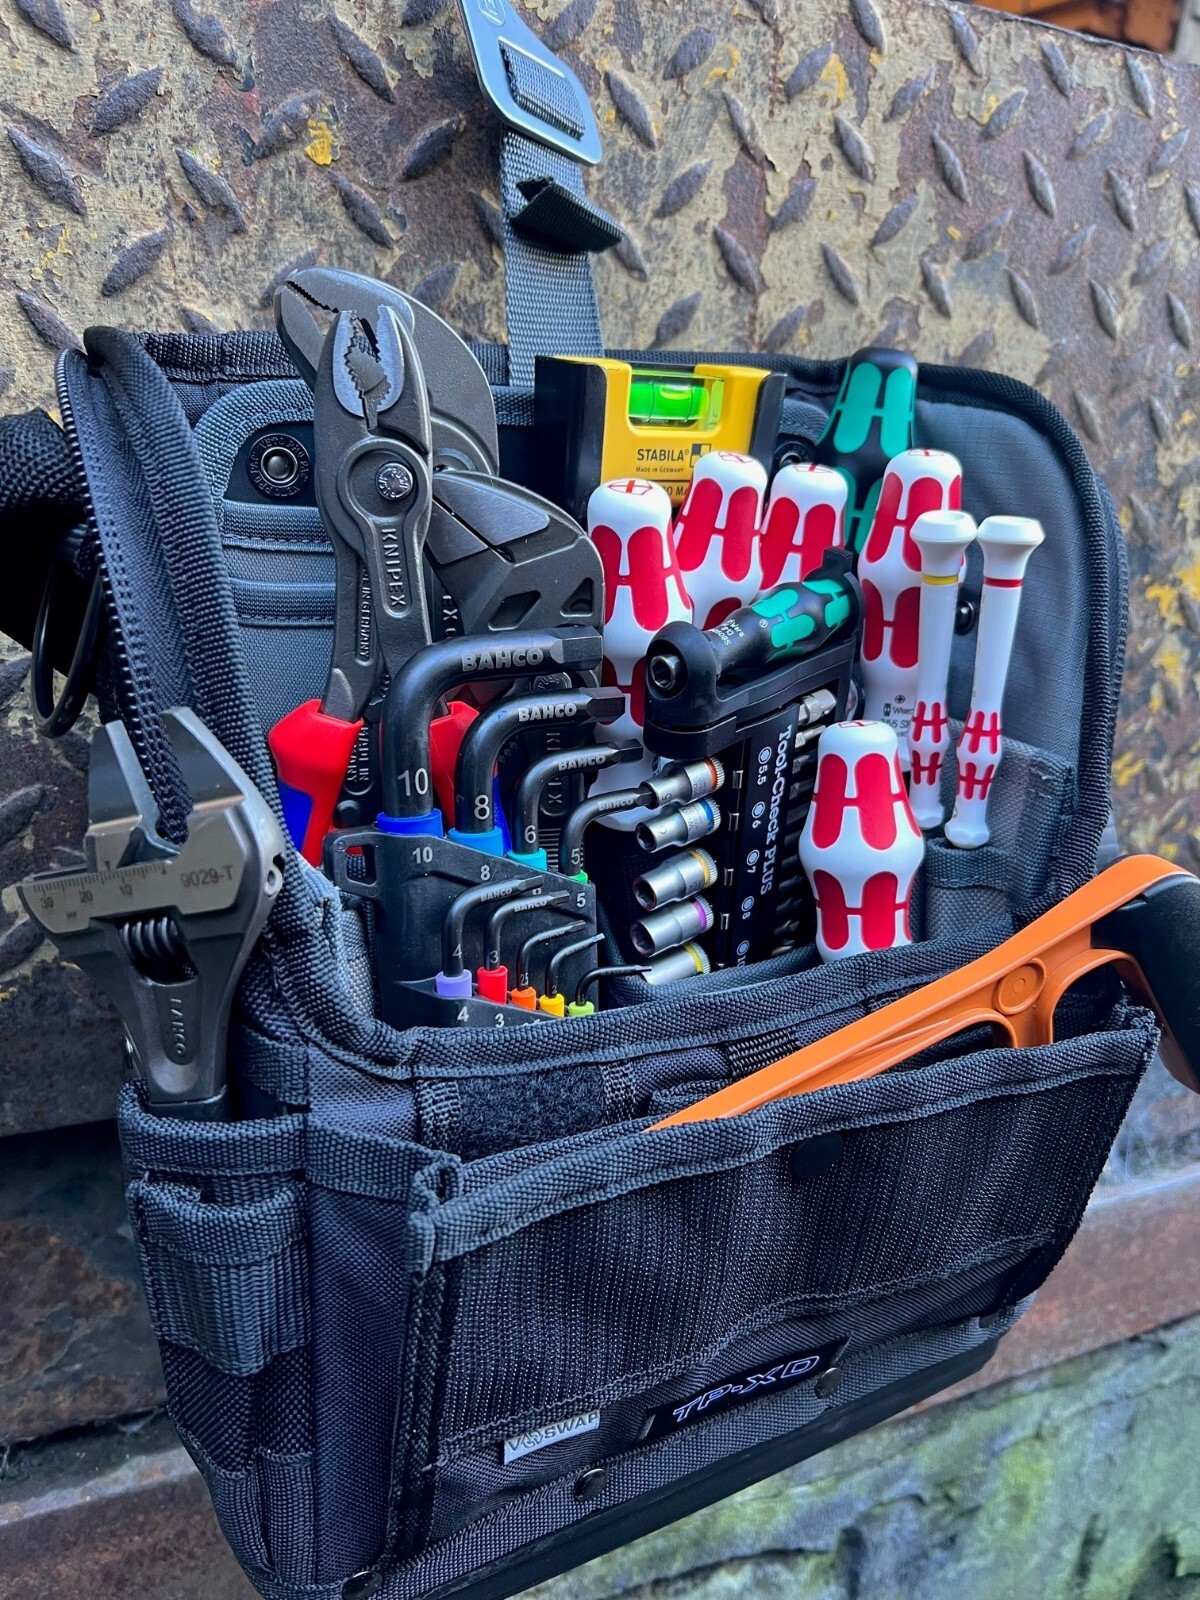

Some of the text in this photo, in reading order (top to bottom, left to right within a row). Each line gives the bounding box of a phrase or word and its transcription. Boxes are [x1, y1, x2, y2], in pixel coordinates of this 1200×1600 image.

[381, 528, 406, 607] KNIPEX
[462, 647, 544, 672] BAHCO
[517, 702, 578, 722] BAHCO
[558, 754, 607, 772] BAHCO
[397, 767, 429, 797] 10
[757, 764, 769, 786] 5.5
[474, 794, 490, 821] 8
[524, 824, 537, 844] 6
[412, 846, 433, 865] 10
[570, 847, 581, 865] 5
[181, 864, 234, 888] 9029-T
[480, 864, 491, 881] 8
[760, 844, 777, 896] PLUS
[576, 892, 586, 908] 5
[452, 943, 463, 959] 4
[489, 950, 499, 964] 3
[456, 1006, 470, 1022] 4
[494, 1012, 505, 1028] 3
